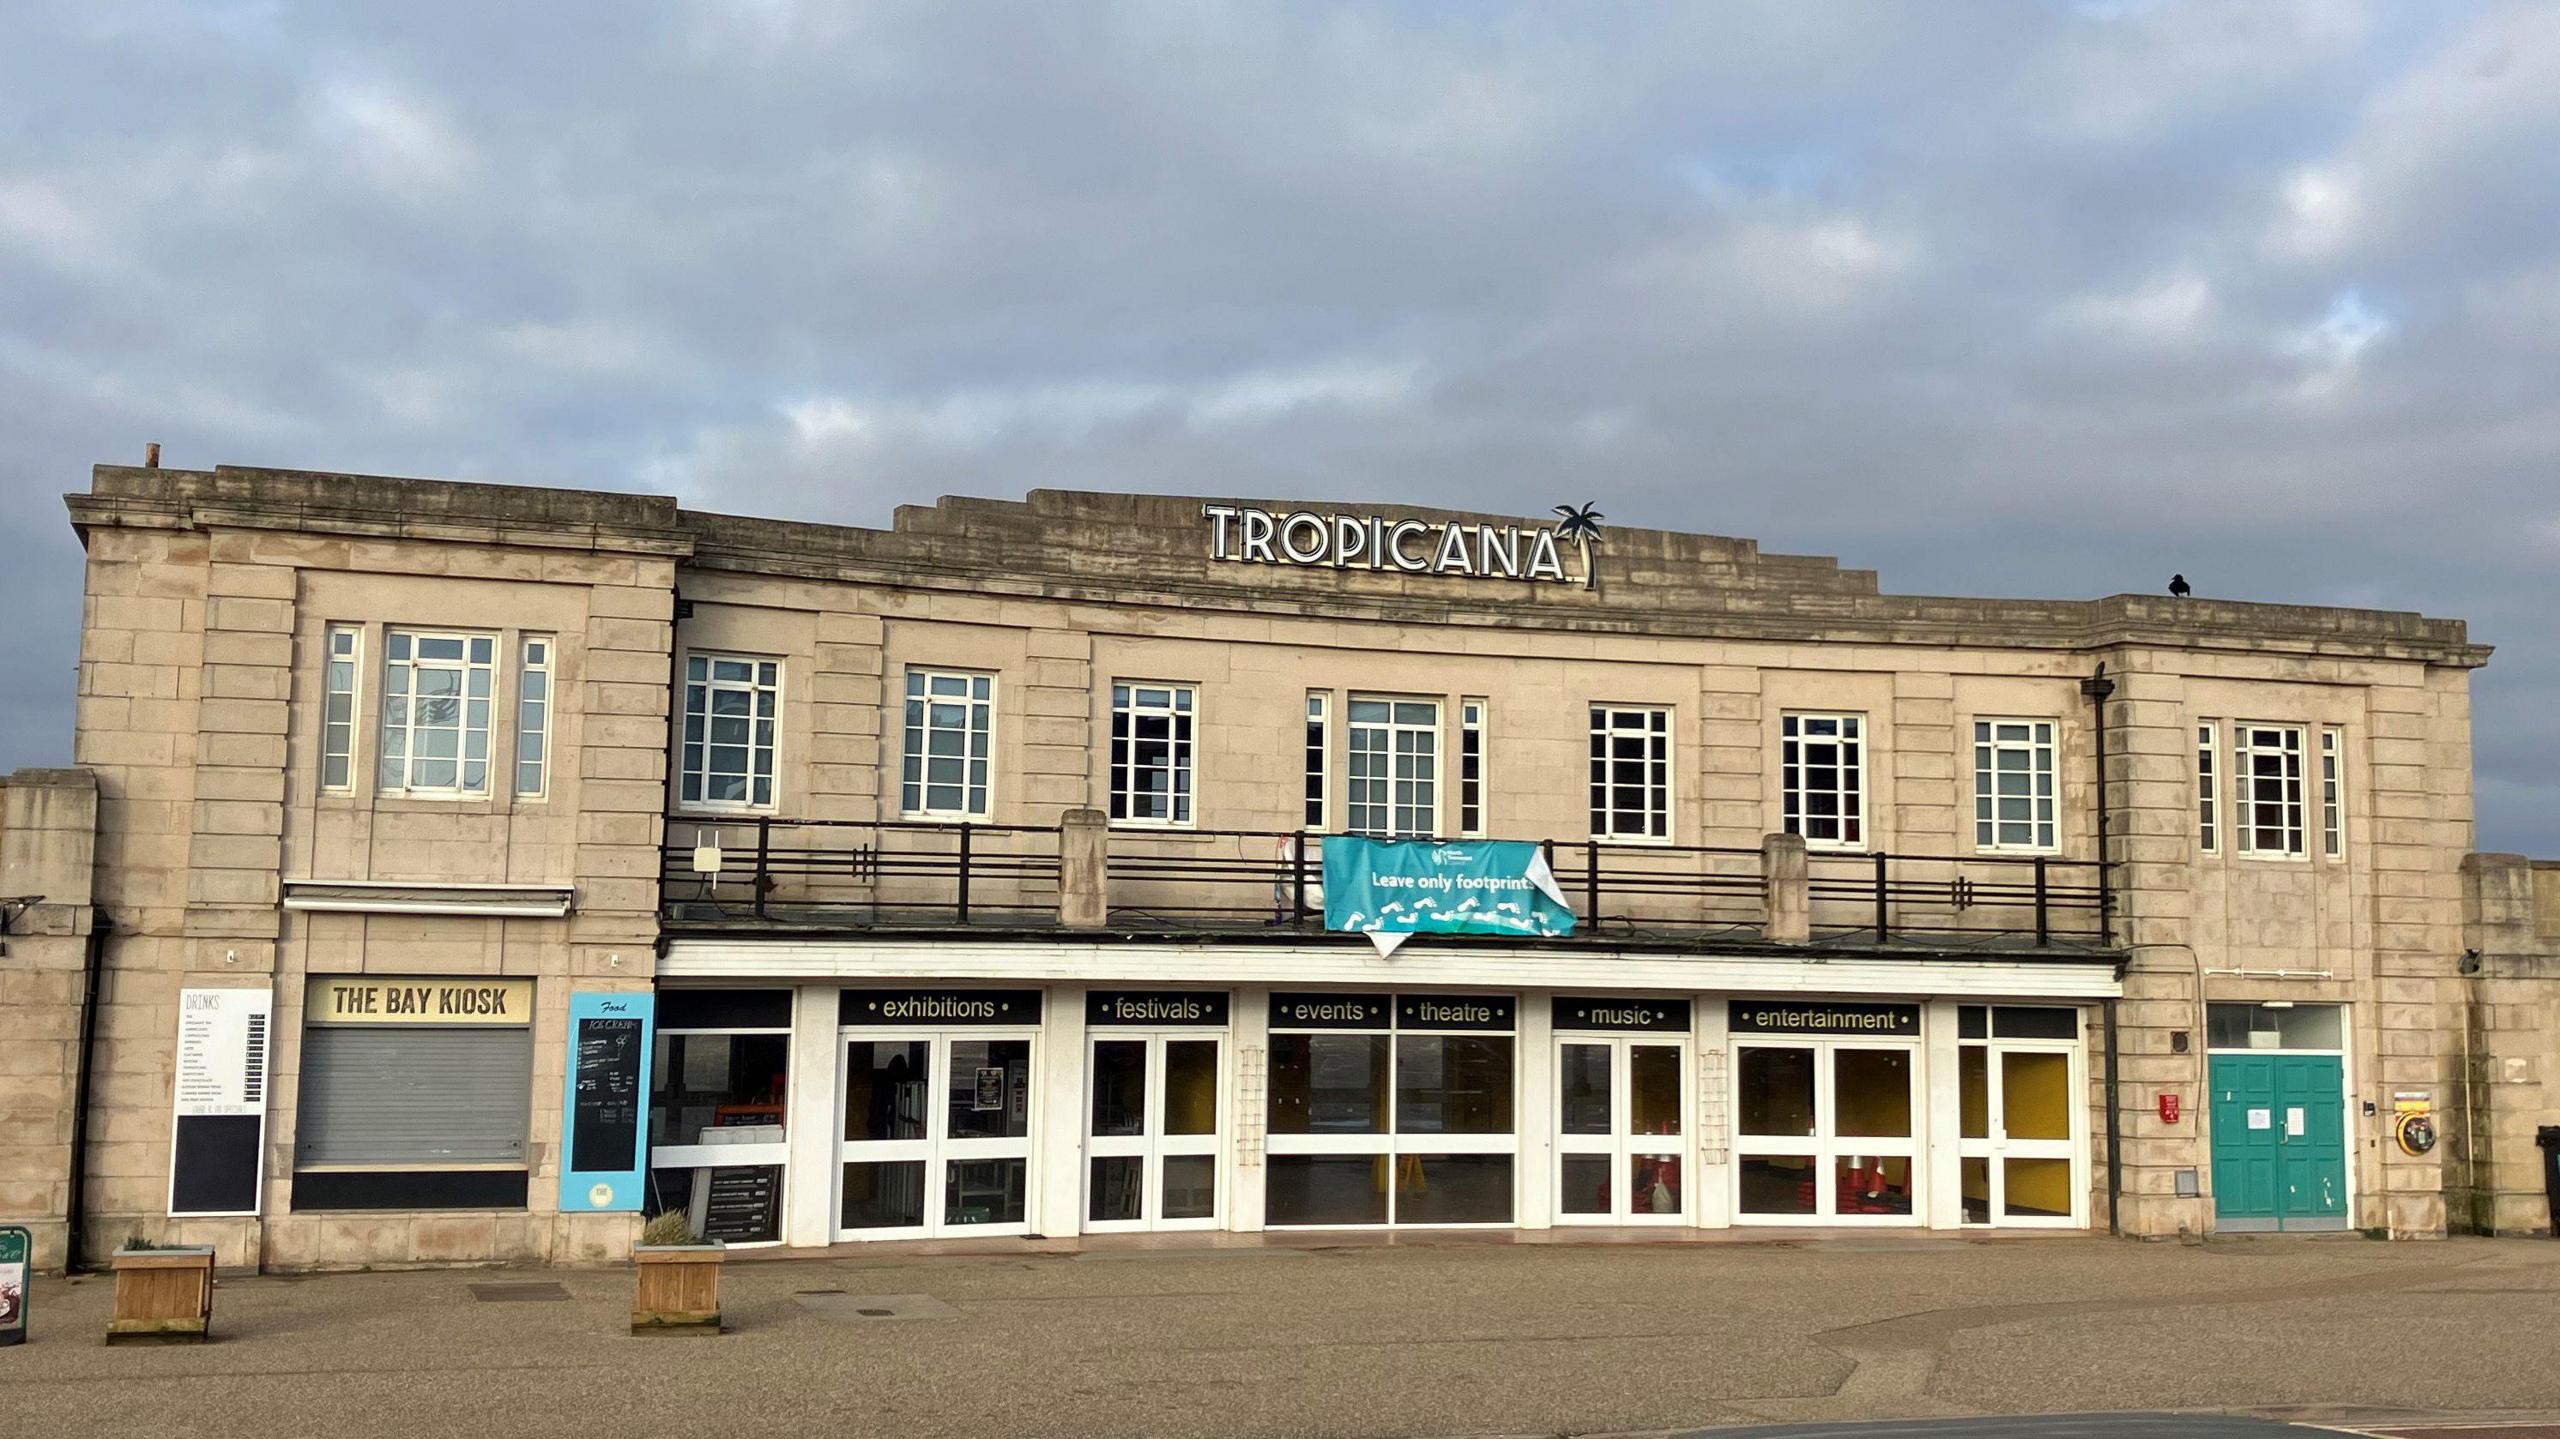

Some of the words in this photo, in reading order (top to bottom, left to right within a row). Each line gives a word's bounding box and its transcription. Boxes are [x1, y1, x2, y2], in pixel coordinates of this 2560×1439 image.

[1204, 503, 1567, 583] TROPICANA
[1372, 871, 1415, 889] Leave
[1417, 872, 1453, 894] only
[185, 993, 221, 1011] DRINKS
[333, 986, 379, 1014] THE
[386, 987, 432, 1015] BAY
[438, 988, 508, 1015] KIOSK
[600, 1000, 628, 1014] Food
[883, 996, 995, 1018] exhibitions
[1115, 997, 1200, 1019] festivals
[1294, 1002, 1365, 1021] events
[1420, 1002, 1491, 1022] theatre
[1591, 1006, 1652, 1025] music
[1755, 1009, 1897, 1029] entertainment
